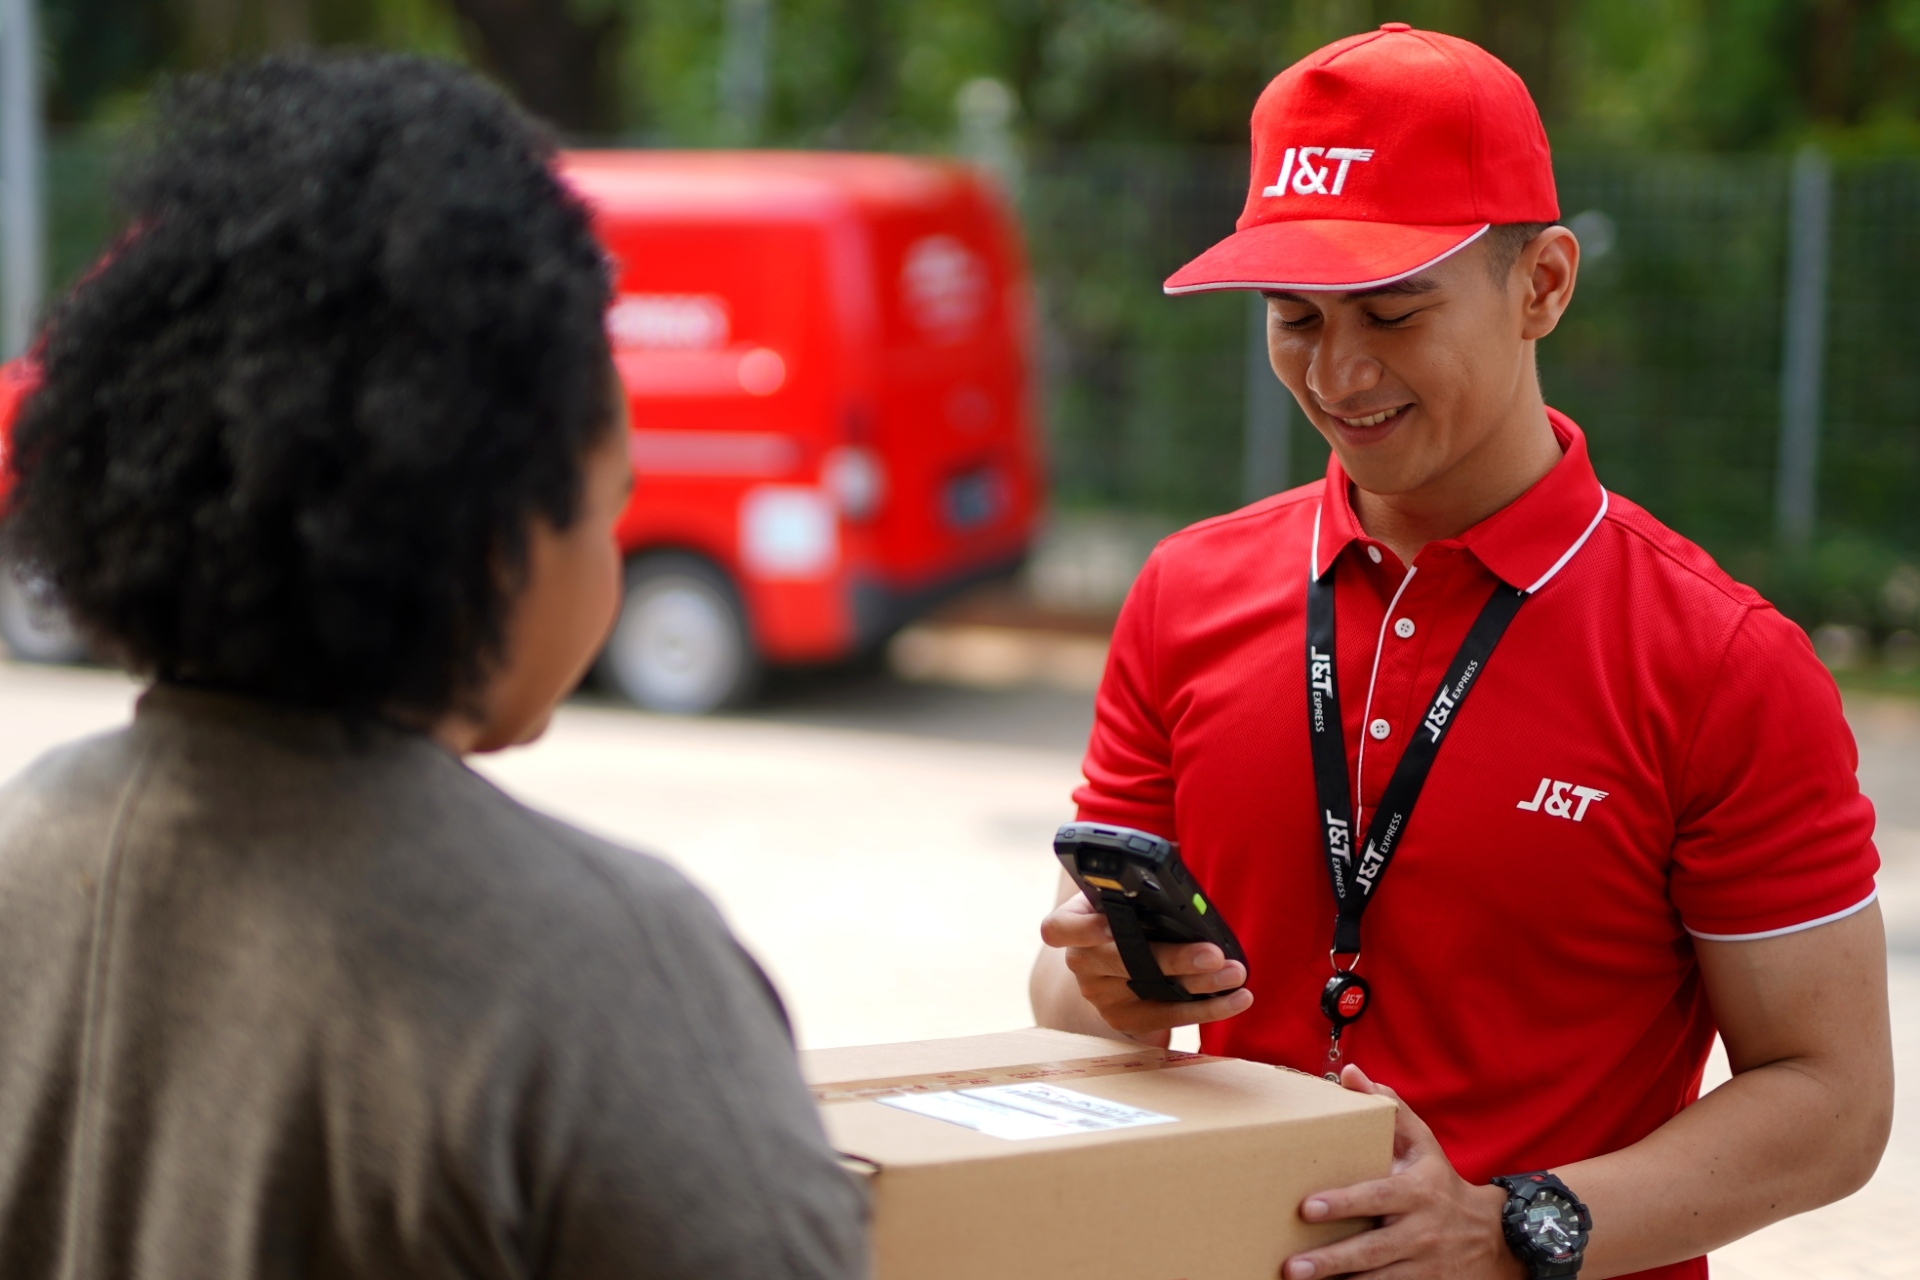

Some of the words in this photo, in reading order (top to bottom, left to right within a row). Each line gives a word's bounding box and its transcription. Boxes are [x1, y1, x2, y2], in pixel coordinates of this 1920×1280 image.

[1262, 146, 1375, 197] J&T
[1311, 645, 1333, 699] J&T
[1313, 691, 1325, 733] EXPRESS
[1424, 684, 1455, 744] J&T
[1452, 659, 1478, 700] EXPRESS
[1516, 777, 1610, 822] J&T
[1326, 809, 1351, 867] J&T
[1356, 838, 1385, 896] J&T
[1380, 812, 1402, 854] EXPRESS
[1341, 993, 1364, 1005] J&T
